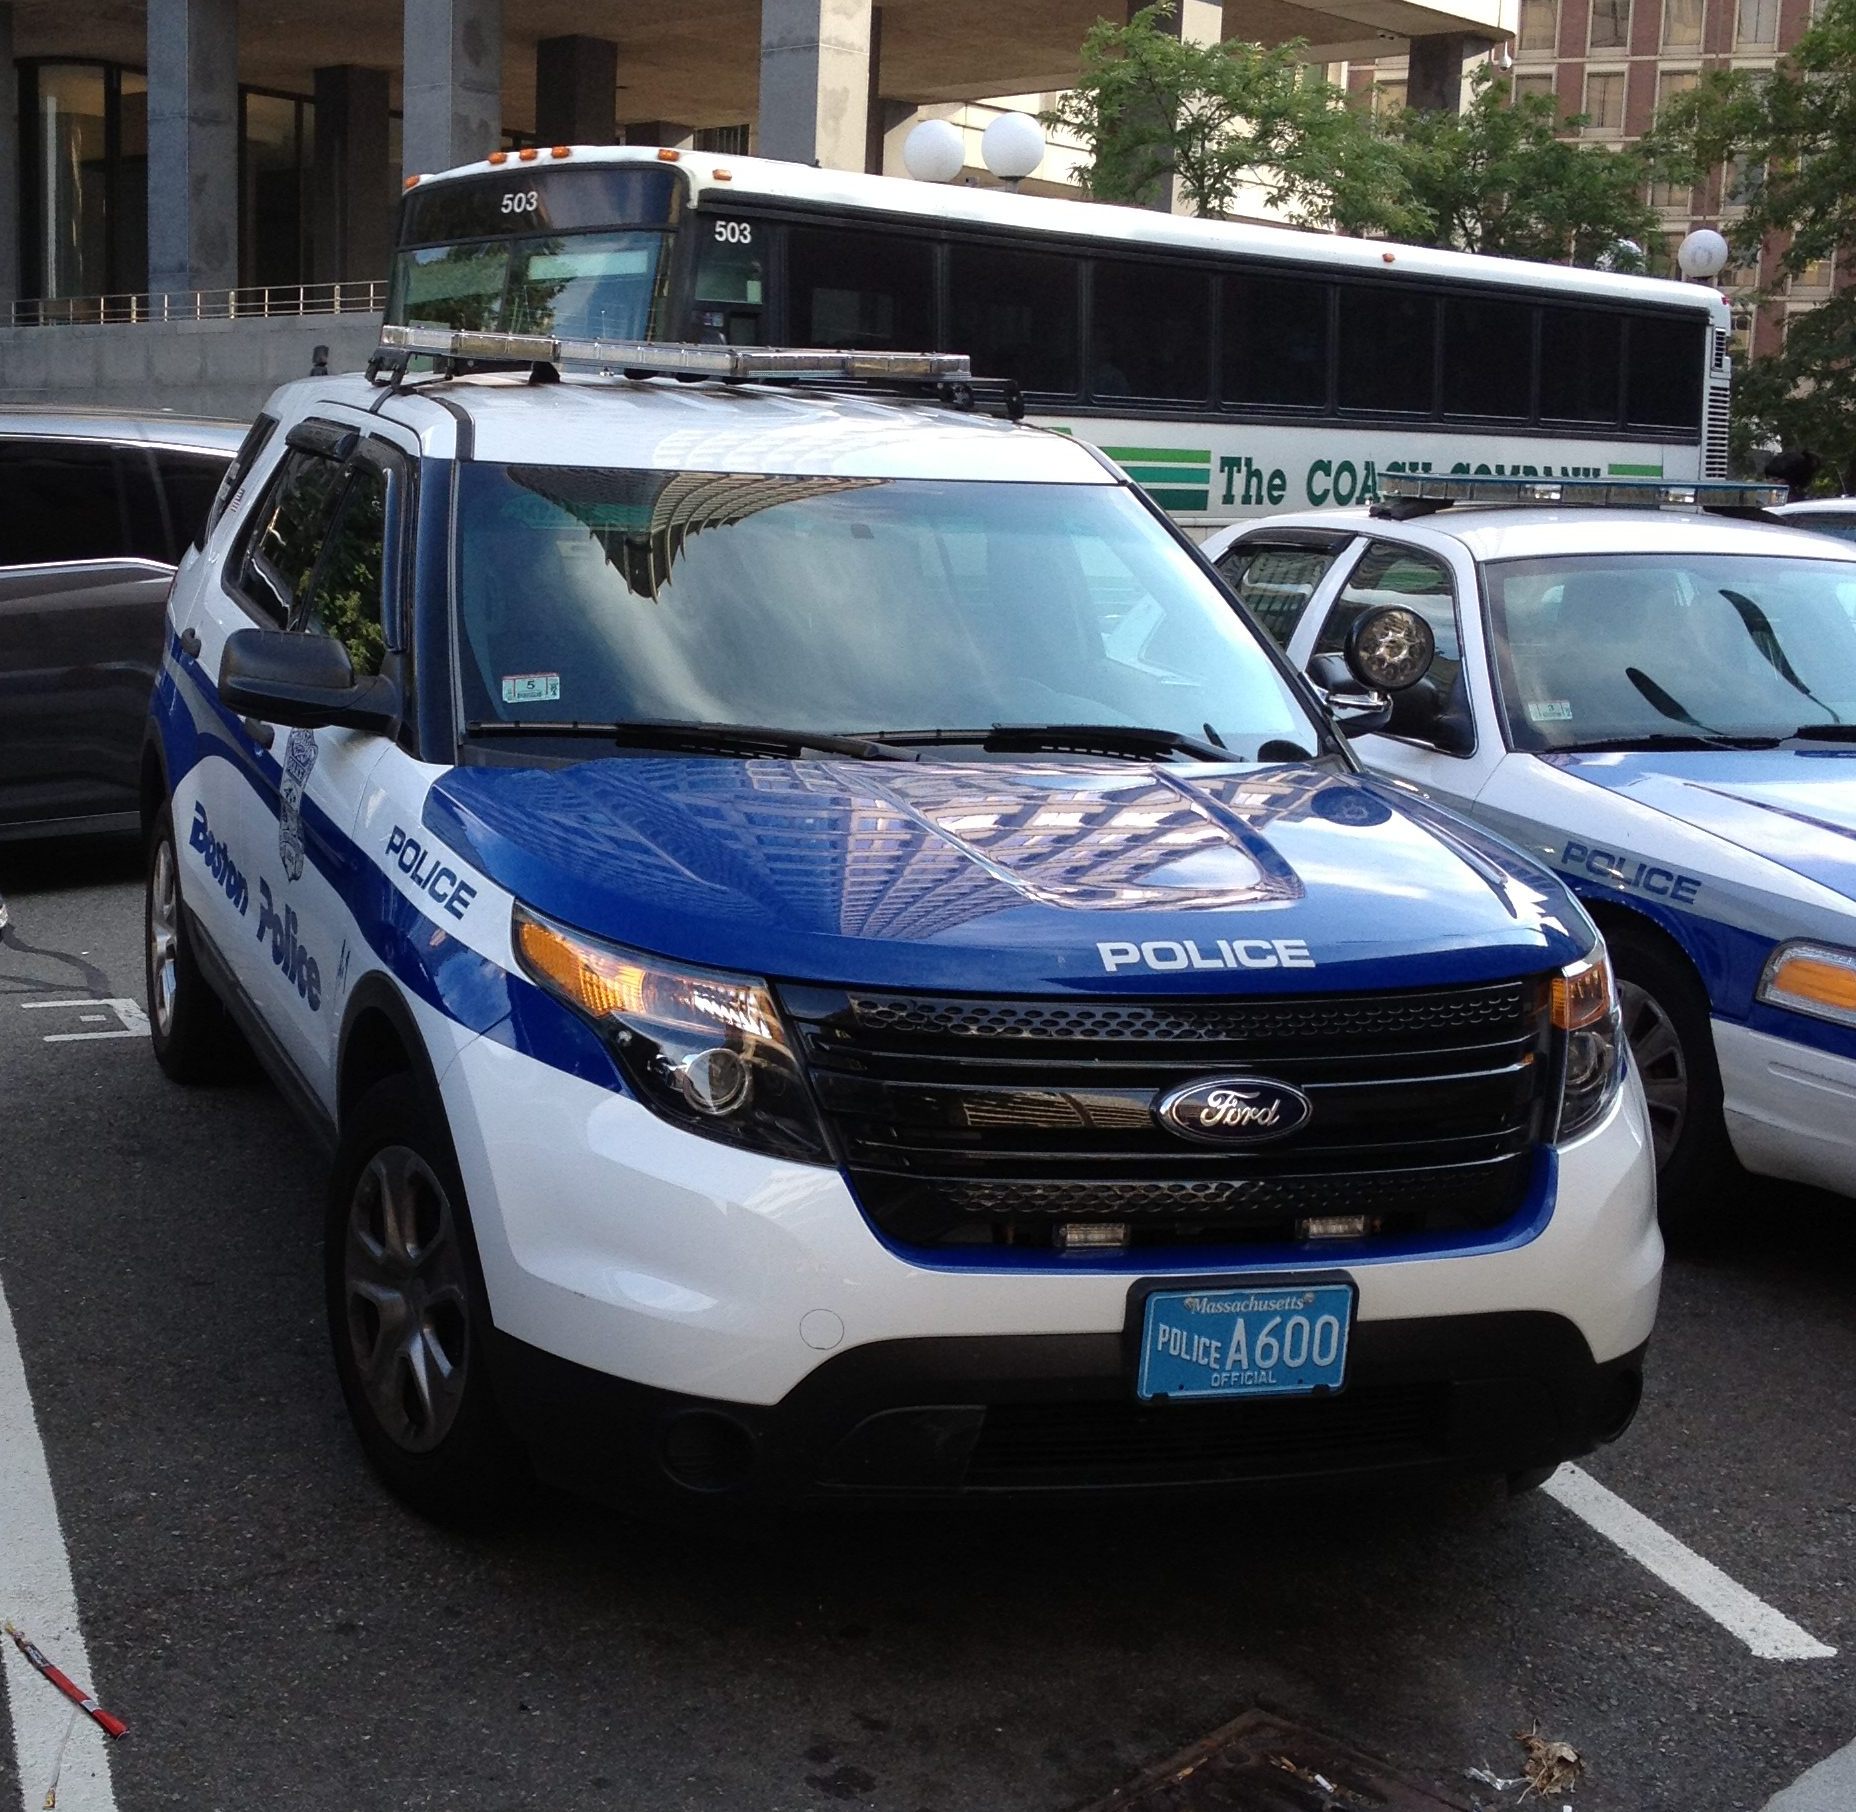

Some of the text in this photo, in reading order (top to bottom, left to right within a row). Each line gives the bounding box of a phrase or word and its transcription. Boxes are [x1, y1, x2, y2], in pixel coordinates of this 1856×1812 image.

[500, 191, 538, 214] 503
[714, 220, 752, 244] 503
[1220, 456, 1432, 506] The COA
[526, 679, 535, 690] 5
[189, 800, 249, 917] Boston
[385, 824, 477, 920] POLICE
[1562, 840, 1702, 905] POLICE
[256, 876, 322, 1012] Police
[1096, 939, 1316, 971] POLICE
[1200, 1090, 1281, 1127] Ford
[1191, 1295, 1305, 1315] Massachusetts
[1157, 1314, 1340, 1371] POLICE A600
[1211, 1371, 1277, 1388] OFFICIAL
